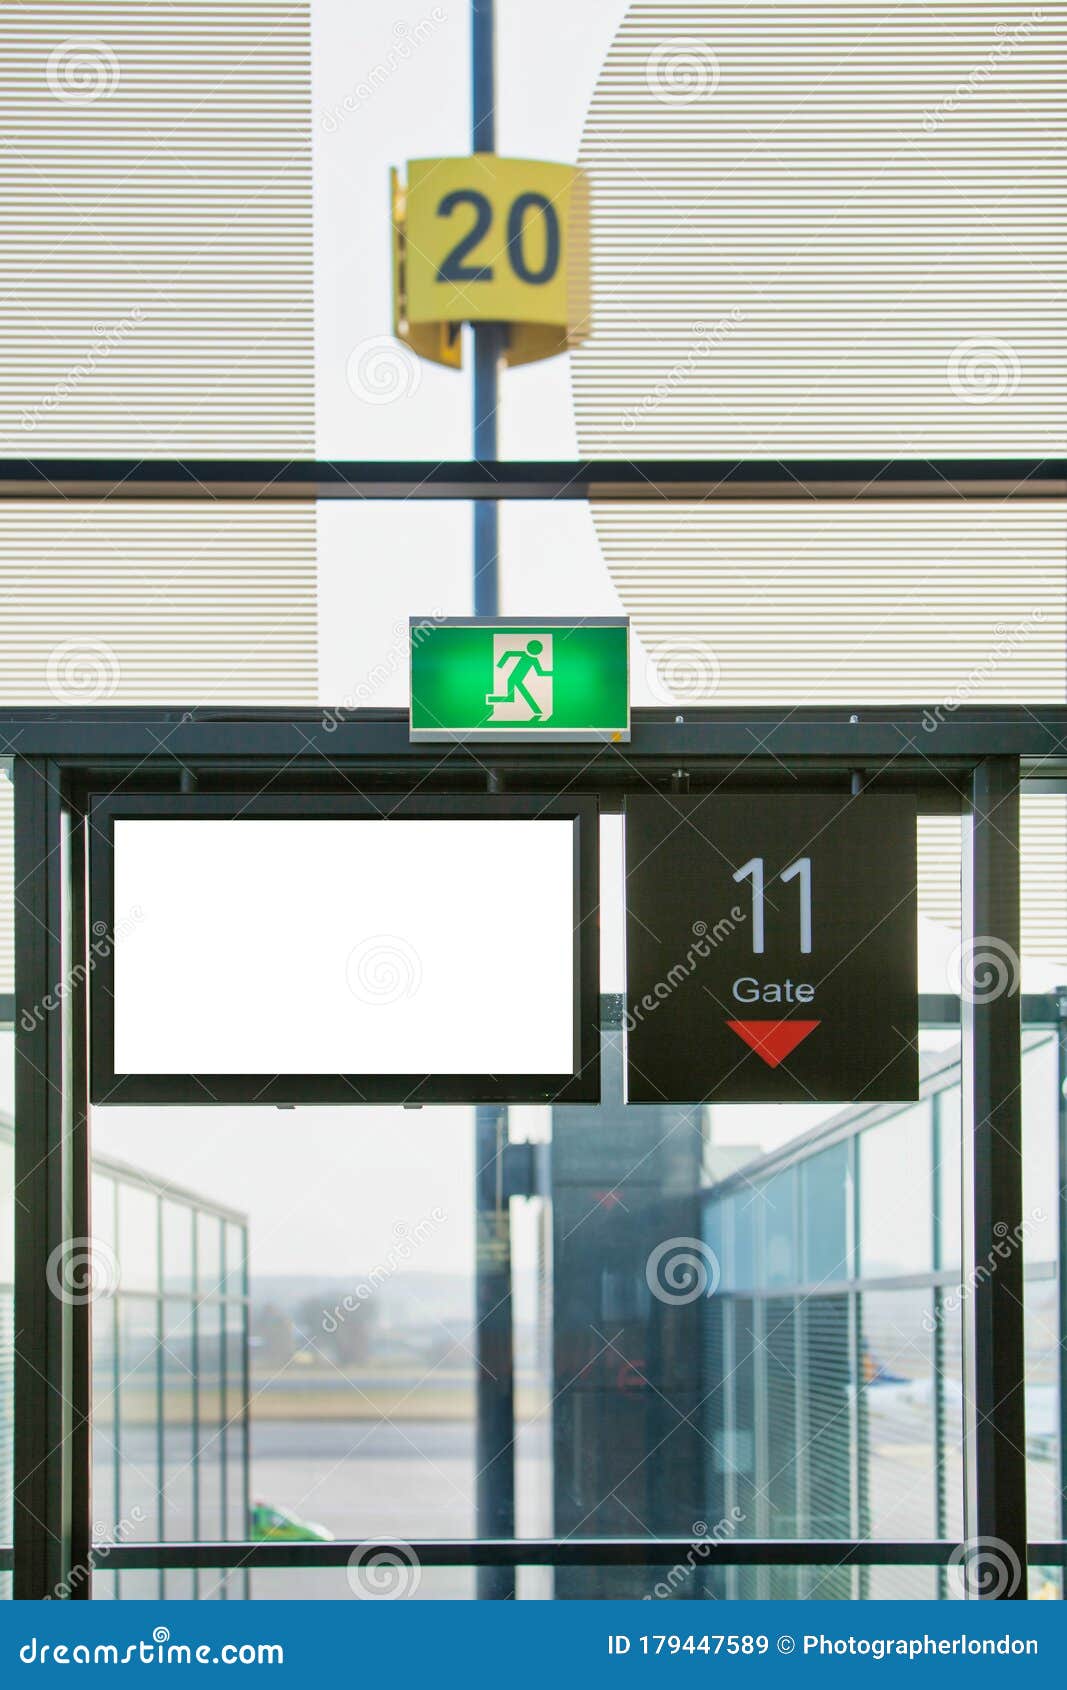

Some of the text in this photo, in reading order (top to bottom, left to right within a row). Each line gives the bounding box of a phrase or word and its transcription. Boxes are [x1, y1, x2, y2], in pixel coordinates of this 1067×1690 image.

[436, 189, 560, 285] 20
[733, 858, 812, 953] 11
[733, 977, 815, 1003] Gate
